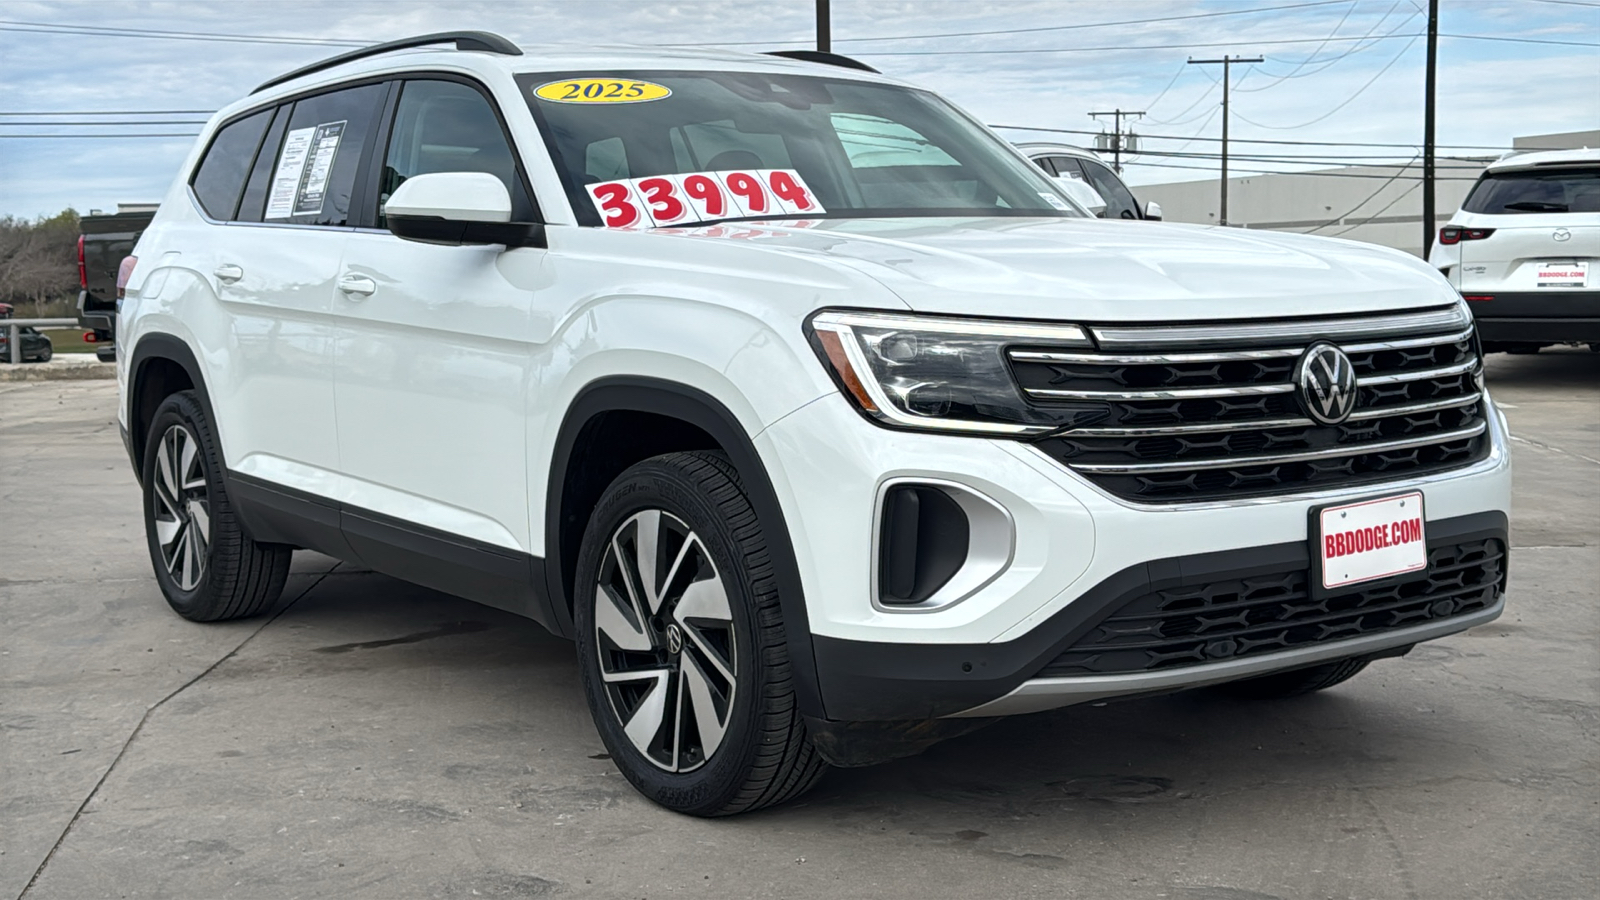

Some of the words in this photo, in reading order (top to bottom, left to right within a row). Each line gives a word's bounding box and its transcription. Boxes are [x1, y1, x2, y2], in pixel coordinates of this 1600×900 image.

[561, 83, 646, 100] 2025
[593, 171, 816, 228] 33994
[1325, 518, 1422, 559] BBDODGE.COM
